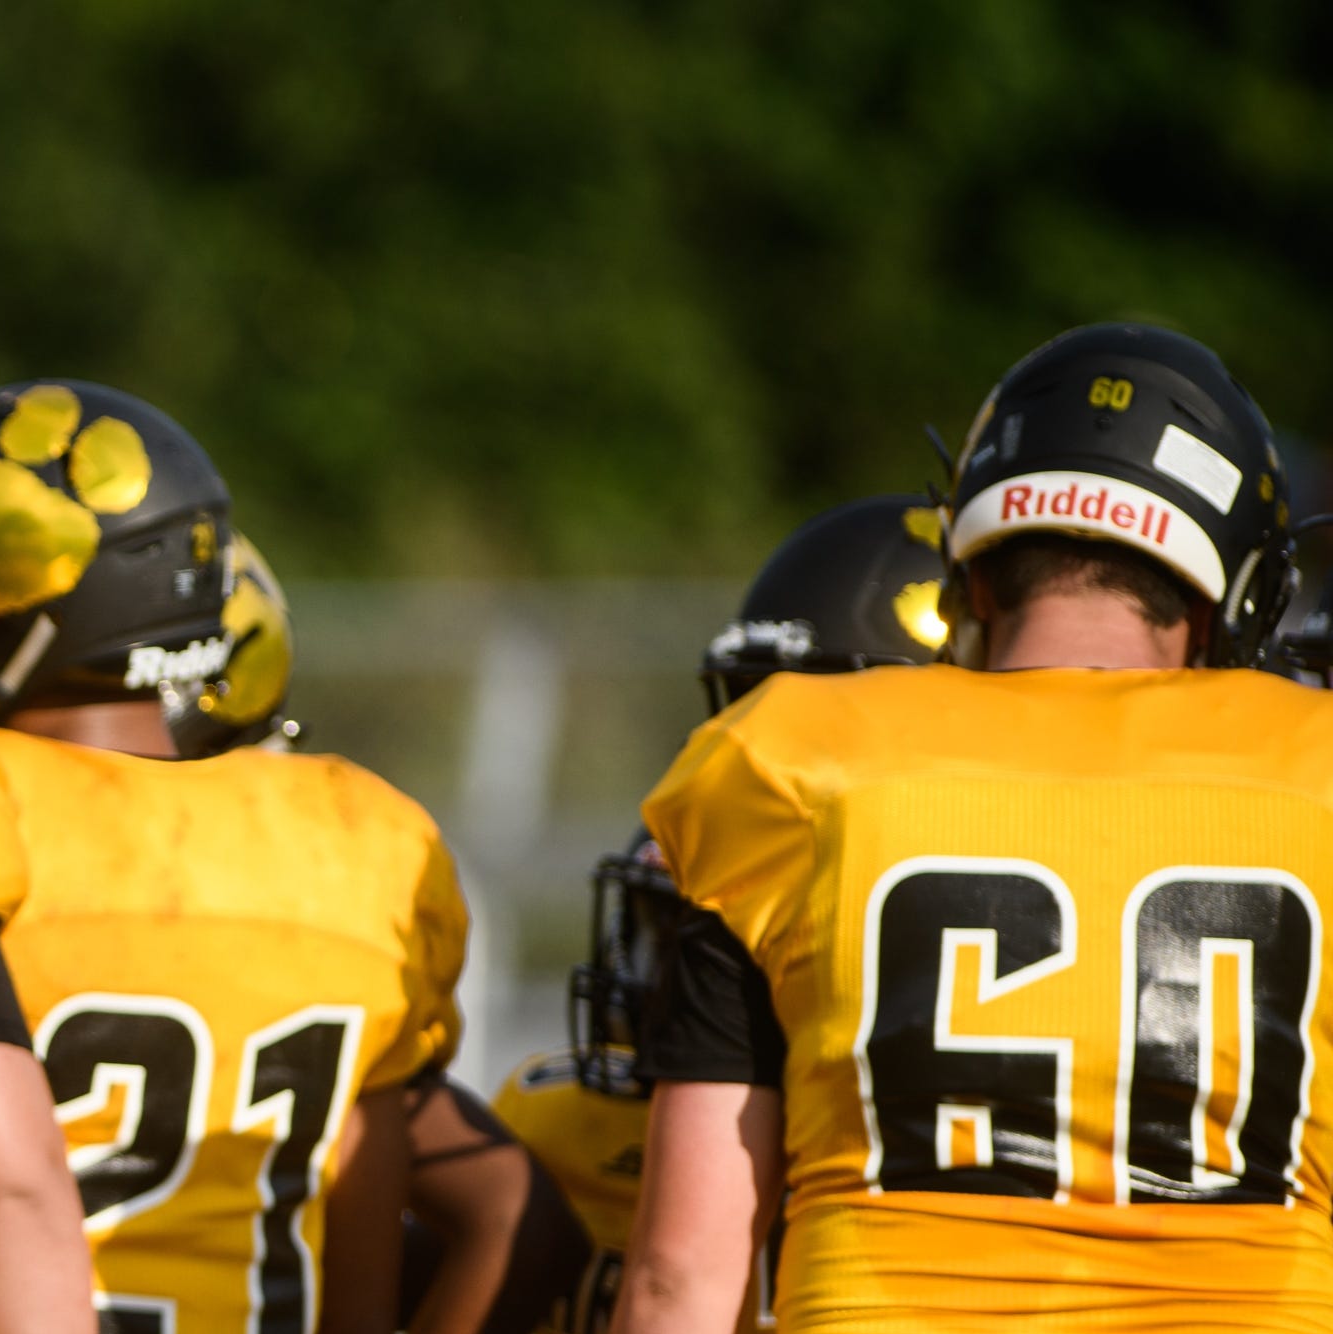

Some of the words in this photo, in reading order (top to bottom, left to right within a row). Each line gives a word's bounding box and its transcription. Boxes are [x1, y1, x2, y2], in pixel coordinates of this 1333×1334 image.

[1088, 376, 1134, 412] 60
[1000, 484, 1171, 546] Riddell
[855, 855, 1323, 1208] 60
